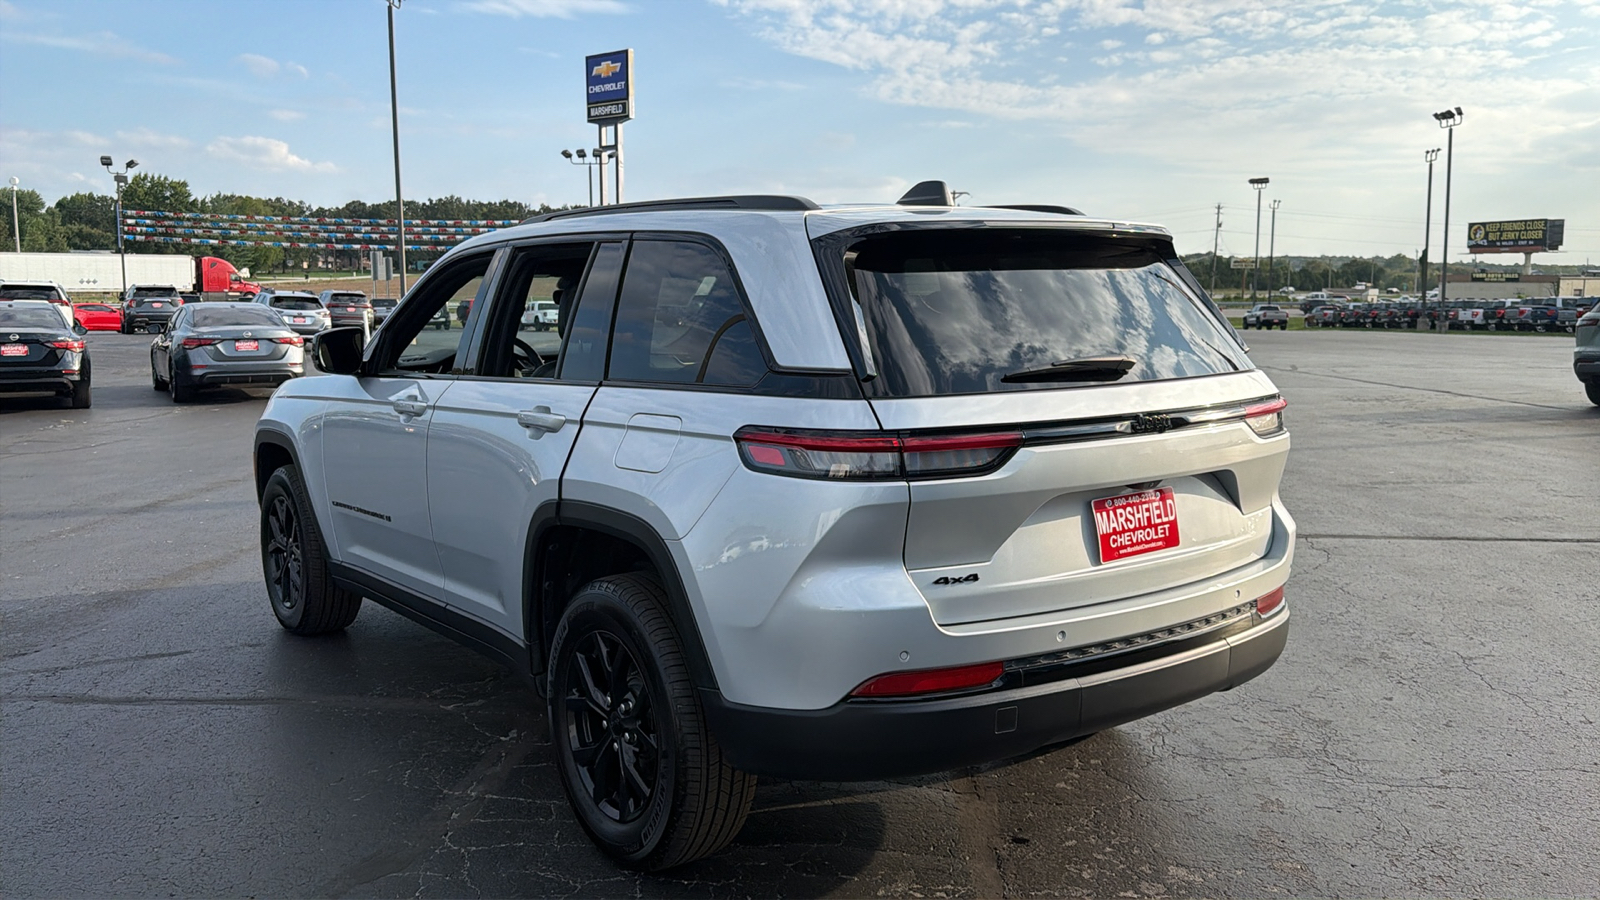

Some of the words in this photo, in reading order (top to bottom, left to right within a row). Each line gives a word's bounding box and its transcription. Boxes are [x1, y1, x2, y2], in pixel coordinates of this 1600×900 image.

[588, 81, 625, 93] CHEVROLET
[590, 104, 623, 116] MARSHFIELD
[1486, 223, 1500, 232] KEEP
[1500, 221, 1526, 231] FRIENDS
[1488, 232, 1501, 241] BUT
[1501, 231, 1520, 240] JERKY
[1520, 230, 1543, 239] CLOSER
[1096, 499, 1176, 535] MARSHFIELD
[1109, 524, 1170, 548] CHEVROLET
[932, 573, 980, 585] 4x4
[643, 783, 665, 844] MICHELIN
